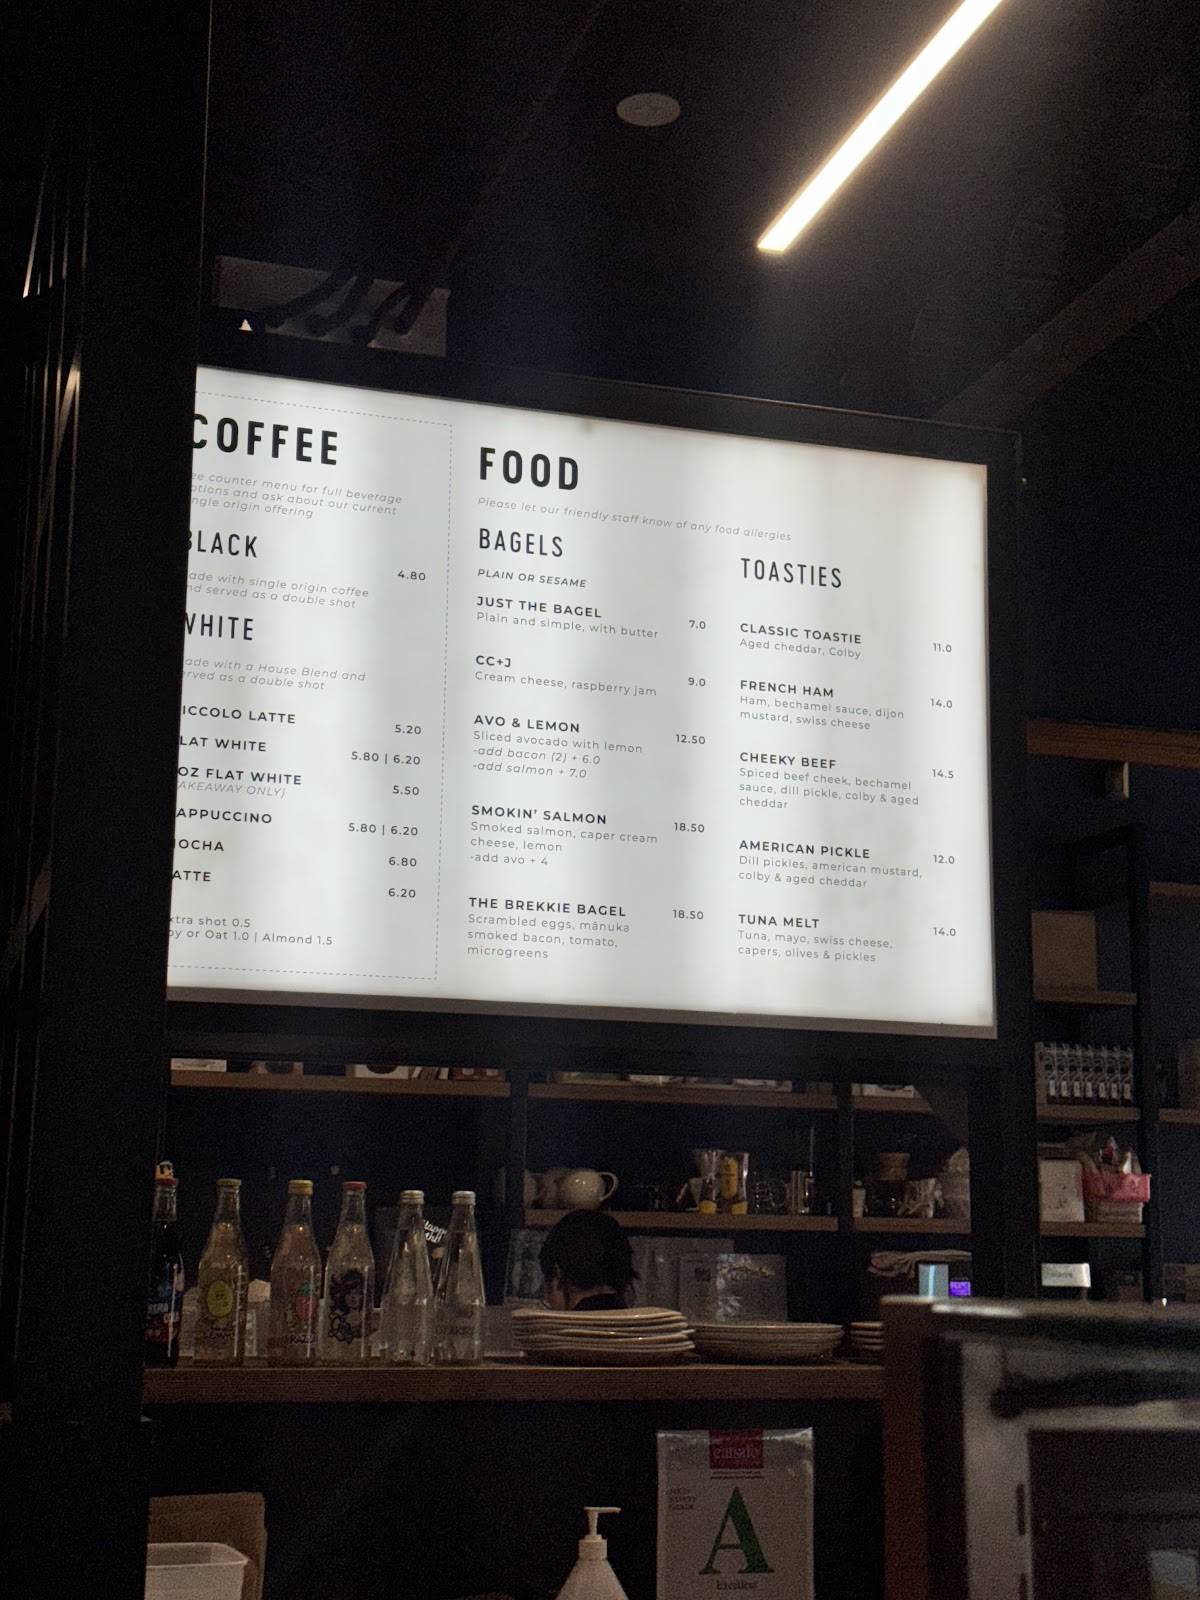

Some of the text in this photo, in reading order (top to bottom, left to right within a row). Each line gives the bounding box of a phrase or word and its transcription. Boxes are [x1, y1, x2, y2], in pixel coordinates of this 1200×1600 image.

[192, 413, 338, 465] COFFEE
[480, 446, 578, 490] FOOD
[208, 474, 402, 504] counter menu for full beverage
[264, 504, 313, 519] offering
[287, 495, 397, 515] about current
[477, 496, 791, 541] Please friendly staff food allergies
[186, 529, 258, 558] LACK
[479, 527, 562, 557] BAGELS
[397, 570, 425, 580] 4.80
[477, 568, 586, 587] PLAIN OR SESAME
[740, 557, 841, 588] TOASTIES
[249, 577, 368, 597] single origin coffee
[282, 593, 355, 608] double shot
[476, 596, 601, 617] JUST THE BAGEL
[476, 611, 507, 623] Plain
[620, 626, 658, 638] butter
[688, 619, 706, 629] 7.0
[740, 623, 861, 644] CLASSIC TOASTIE
[739, 638, 769, 650] Aged
[829, 646, 860, 660] Colby
[932, 642, 952, 652] 11.0
[475, 655, 511, 667] CC+J
[258, 663, 338, 679] House Blend
[474, 670, 515, 683] Cream
[571, 681, 630, 695] raspberry
[632, 687, 656, 696] jam
[687, 677, 705, 687] 9.0
[740, 679, 833, 697] FRENCH HAM
[774, 697, 831, 711] bechamel
[875, 707, 903, 719] dijon
[930, 698, 952, 708] 14.0
[182, 705, 295, 723] ICCOLO LATTE
[394, 724, 421, 734] 5.20
[473, 714, 579, 733] AVO & LEMON
[830, 718, 870, 730] cheese
[179, 733, 266, 751] LAT WHITE
[471, 730, 642, 752] Sliced avocado lemon
[675, 733, 705, 744] 12.50
[351, 751, 420, 765] 5.80 6.20
[507, 747, 545, 760] bacon
[582, 754, 600, 764] 6.0
[739, 751, 835, 768] CHEEKY BEEF
[206, 768, 244, 780] FLAT
[250, 771, 301, 785] WHITE
[506, 764, 552, 775] salmon
[569, 768, 586, 778] 7.0
[739, 767, 779, 779] Spiced
[783, 770, 809, 781] beef
[855, 776, 911, 790] bechamel
[932, 768, 954, 779] 14.5
[392, 784, 419, 795] 5.50
[739, 796, 787, 808] cheddar
[845, 791, 876, 803] colby
[890, 796, 918, 806] aged
[176, 808, 272, 823] APPUCCINO
[543, 810, 606, 824] SALMON
[348, 822, 417, 836] 5.80 6.20
[471, 821, 521, 834] Smoked
[580, 831, 615, 840] caper
[619, 833, 657, 843] cream
[674, 822, 704, 832] 18.50
[173, 836, 224, 852] OCHA
[523, 839, 562, 851] lemon
[739, 839, 870, 858] AMERICAN PICKLE
[388, 856, 416, 867] 6.80
[739, 855, 758, 865] Dill
[811, 862, 866, 873] american
[932, 854, 954, 864] 12.0
[172, 867, 211, 882] ATTE
[738, 871, 866, 887] colby cheddar
[388, 887, 415, 898] 6.20
[468, 897, 625, 916] THE BREKKIE BAGEL
[672, 909, 703, 919] 18.50
[198, 916, 250, 928] shot 0.5
[468, 913, 536, 927] Scrambled
[738, 913, 819, 928] TUNA MELT
[204, 929, 332, 945] Oat 1.0 Almond 1.5
[467, 930, 517, 941] smoked
[933, 926, 956, 936] 14.0
[813, 935, 844, 945] swiss
[467, 945, 548, 958] microgreens
[785, 947, 819, 958] olives
[834, 951, 876, 962] pickles
[699, 1486, 775, 1575] A
